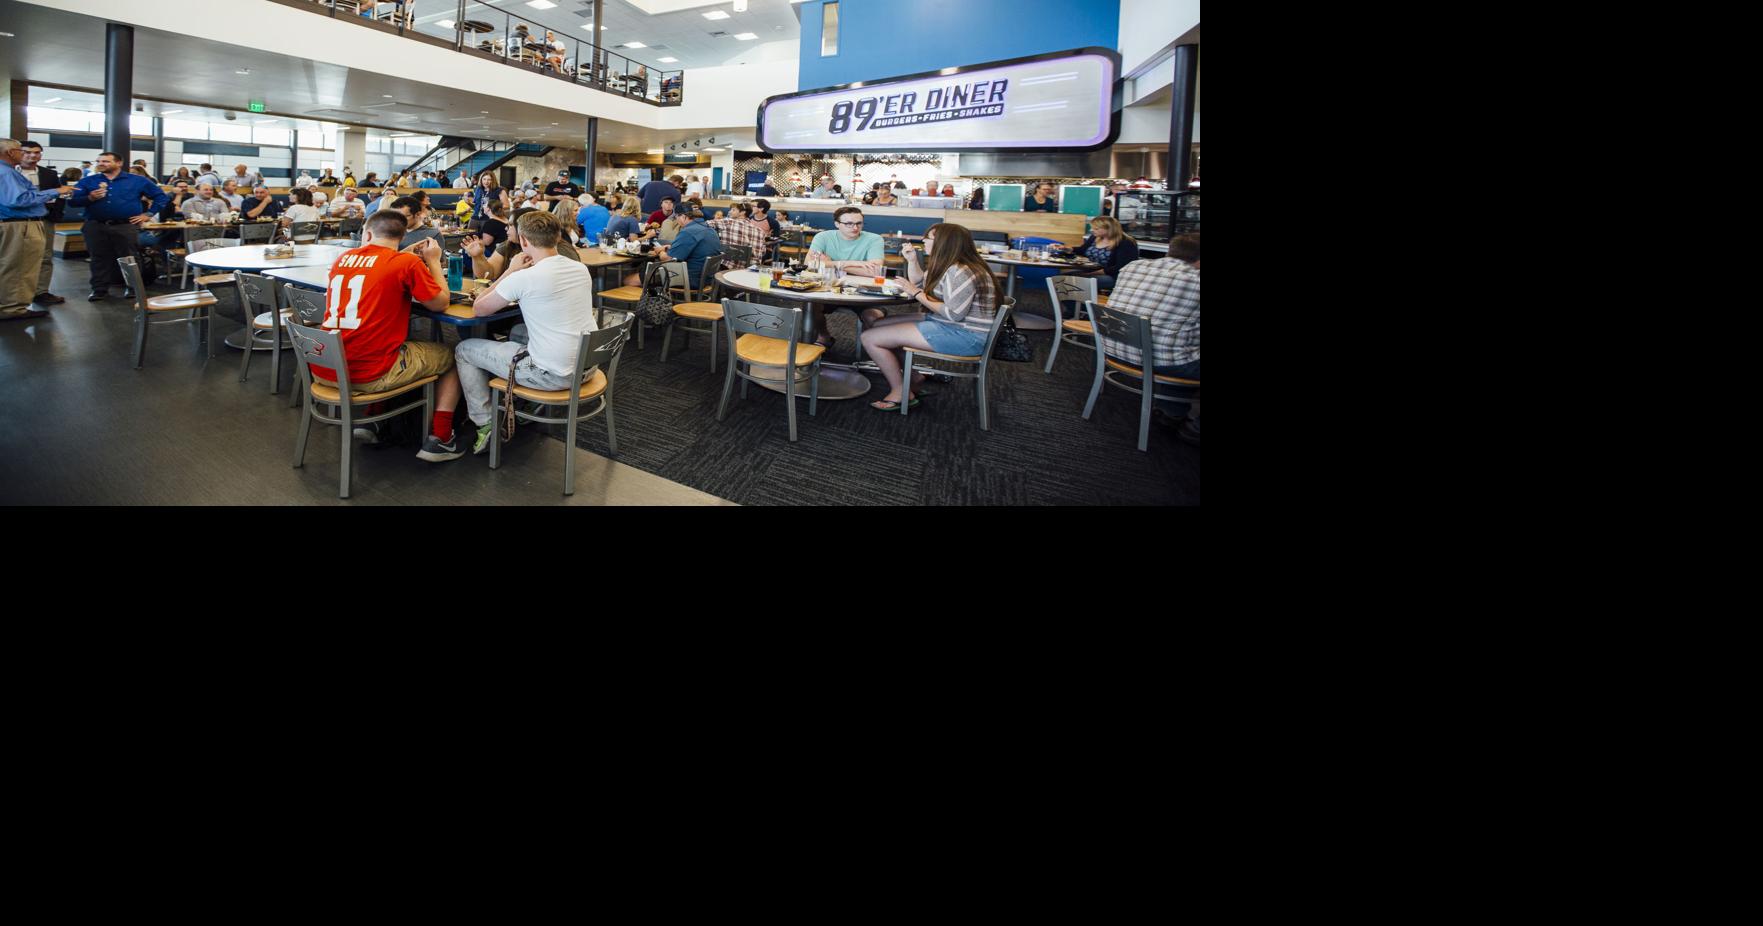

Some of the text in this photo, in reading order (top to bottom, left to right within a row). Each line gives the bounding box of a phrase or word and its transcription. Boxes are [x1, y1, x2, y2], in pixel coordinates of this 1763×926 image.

[250, 103, 264, 112] EXIT
[925, 78, 1008, 111] DINER
[322, 274, 366, 330] 11
